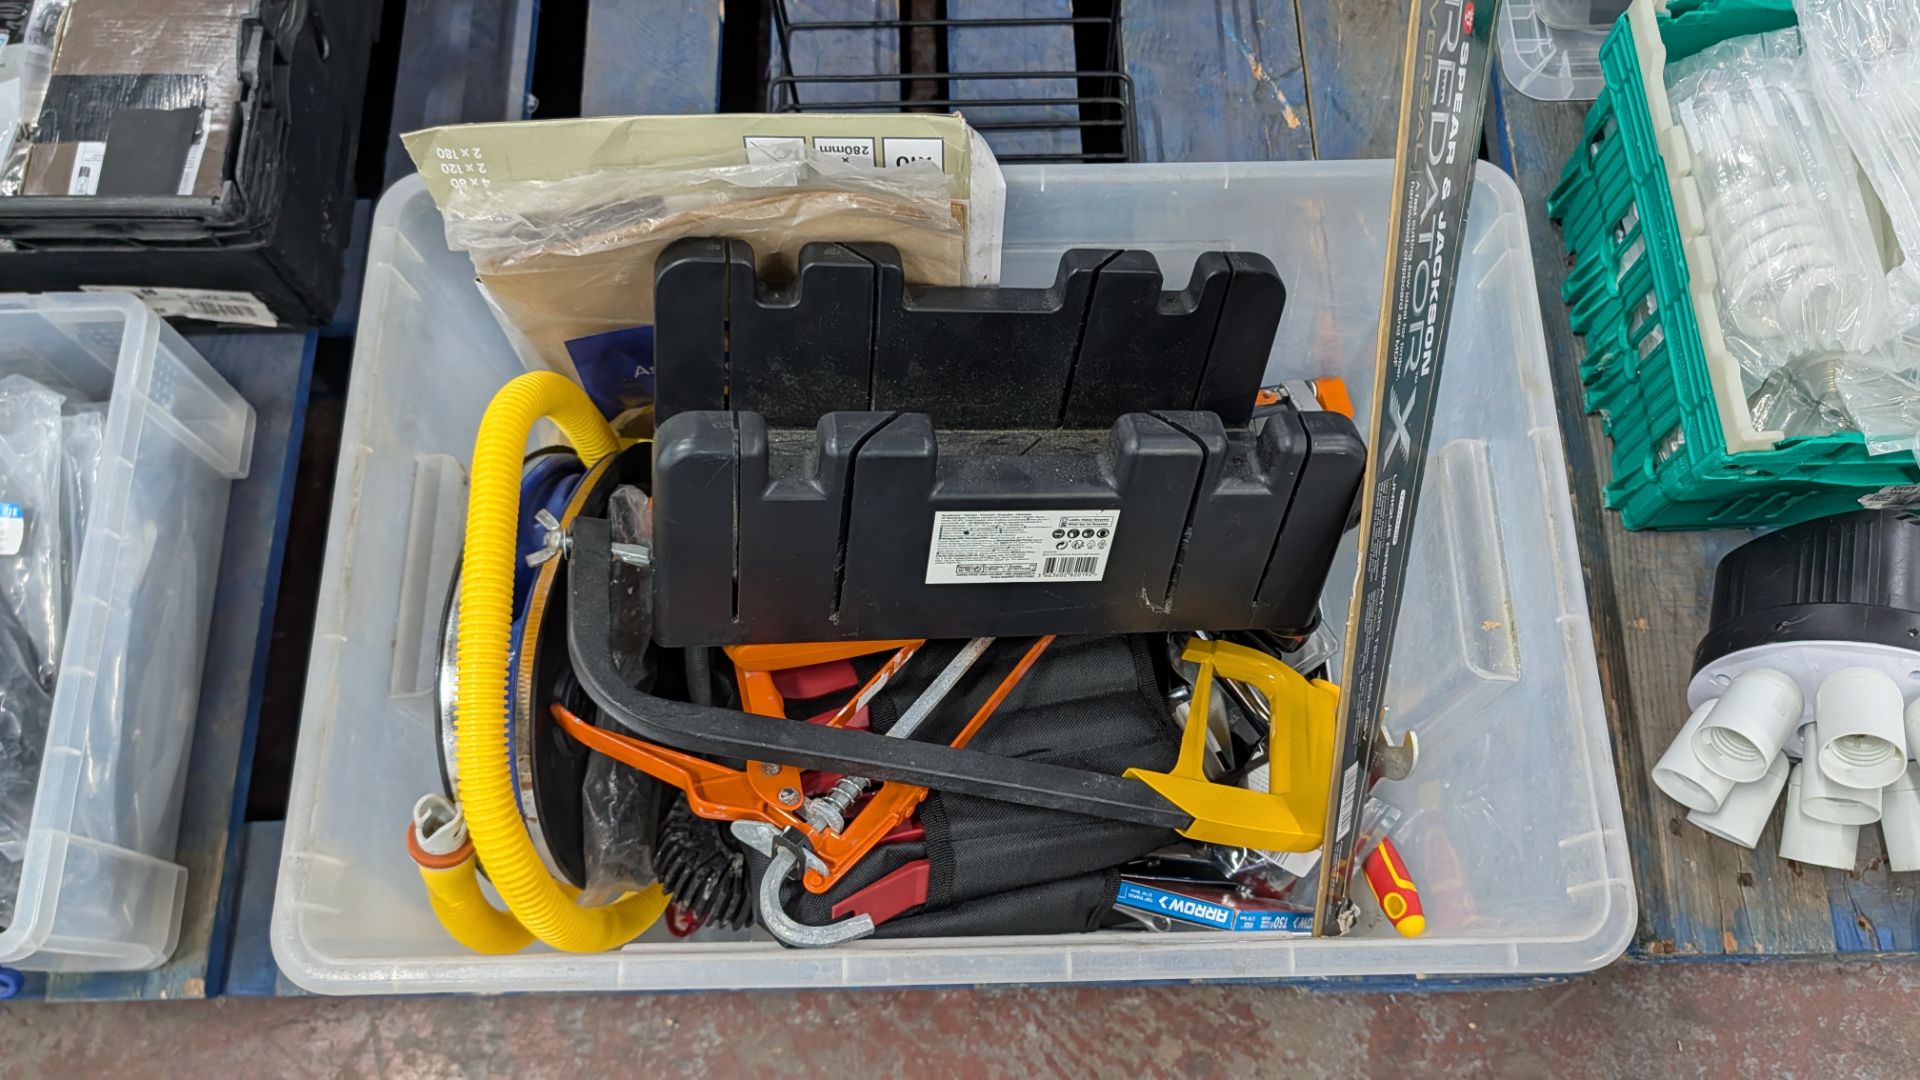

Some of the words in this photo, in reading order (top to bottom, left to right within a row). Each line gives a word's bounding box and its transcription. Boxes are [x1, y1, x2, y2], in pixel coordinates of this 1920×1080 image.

[1446, 42, 1469, 164] SPEAR
[436, 147, 459, 160] 180
[460, 148, 470, 157] x
[472, 148, 482, 159] 2
[819, 145, 870, 155] 280mm
[441, 163, 464, 174] 120
[464, 164, 474, 172] x
[476, 163, 487, 174] 2
[469, 178, 479, 186] x
[481, 178, 490, 188] 4
[1442, 177, 1451, 200] &
[1404, 181, 1415, 246] hardwood,
[1408, 219, 1416, 261] cutting
[1398, 250, 1408, 311] chipboard
[1421, 211, 1446, 376] JACKSON
[1387, 474, 1397, 538] UNIQUE
[1376, 542, 1390, 632] PREDATOR
[1363, 635, 1379, 741] TECHNOLOGY
[1168, 897, 1229, 923] ARROW
